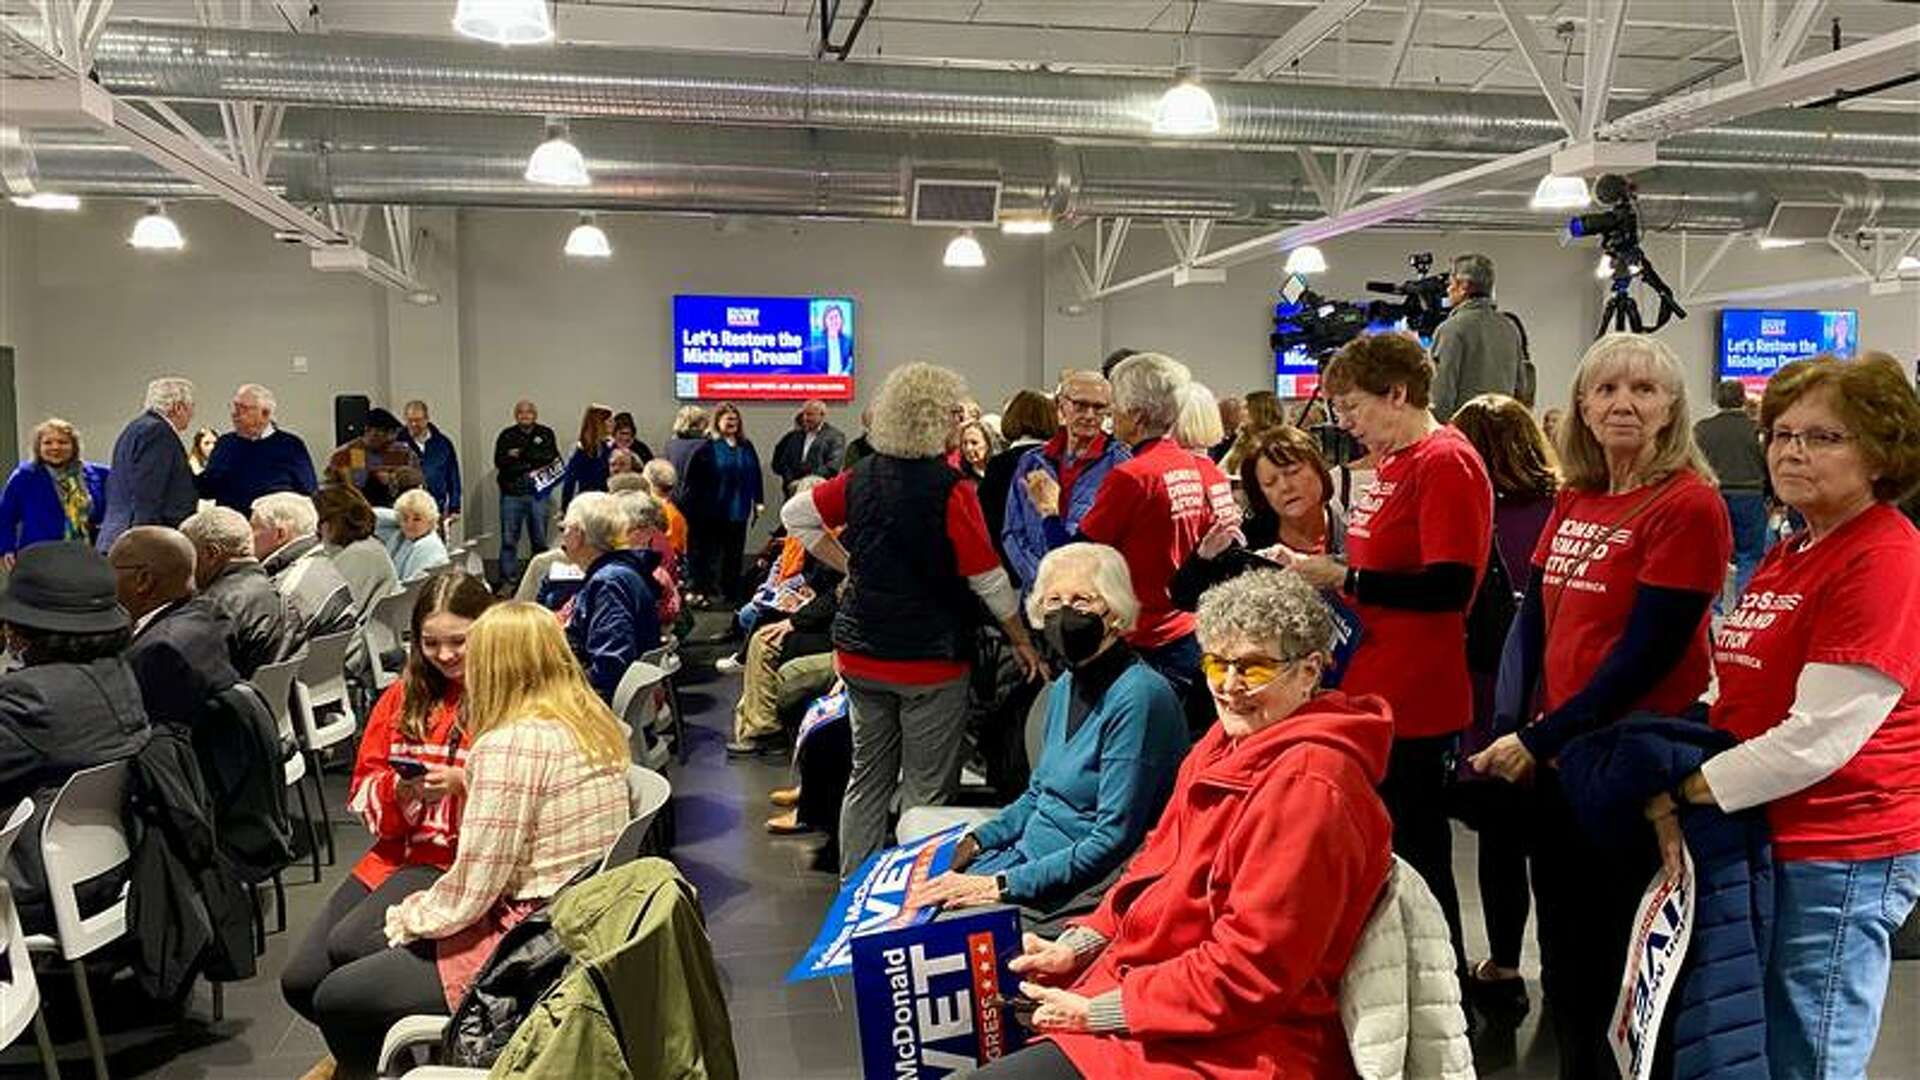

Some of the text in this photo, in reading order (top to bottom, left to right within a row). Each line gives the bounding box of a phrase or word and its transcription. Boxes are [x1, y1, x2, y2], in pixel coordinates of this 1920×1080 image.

[683, 329, 802, 347] Let's Restore the
[1727, 338, 1818, 353] Let's Restore the
[683, 348, 802, 368] Michigan Dream!
[1727, 354, 1777, 372] Michigan
[882, 947, 920, 1080] McDonald
